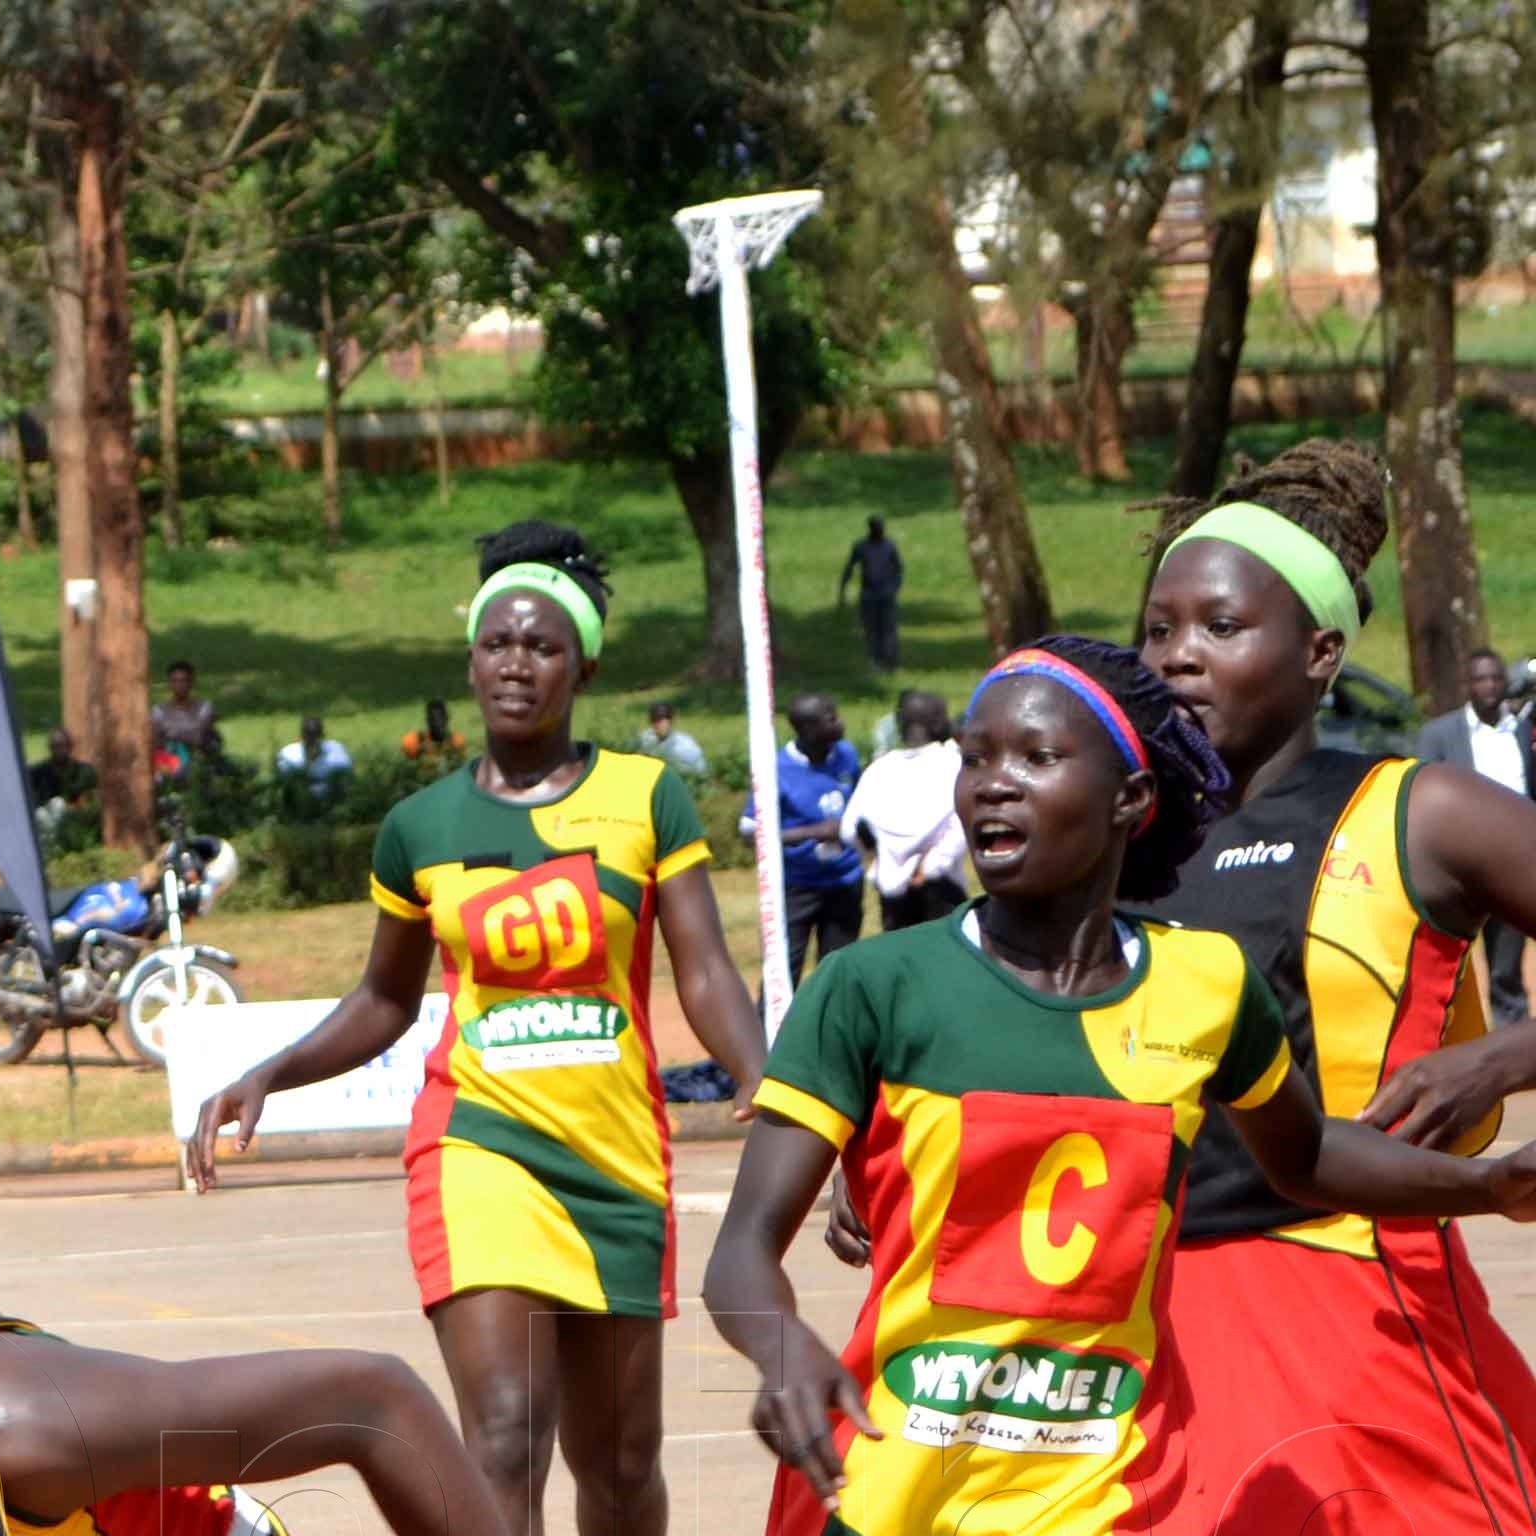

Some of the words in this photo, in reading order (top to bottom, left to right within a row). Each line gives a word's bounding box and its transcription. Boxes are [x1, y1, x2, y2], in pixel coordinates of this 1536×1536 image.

[1214, 840, 1295, 871] mitre
[484, 877, 591, 972] GD
[1020, 1132, 1108, 1286] C
[911, 1350, 1124, 1415] WEYONJE!
